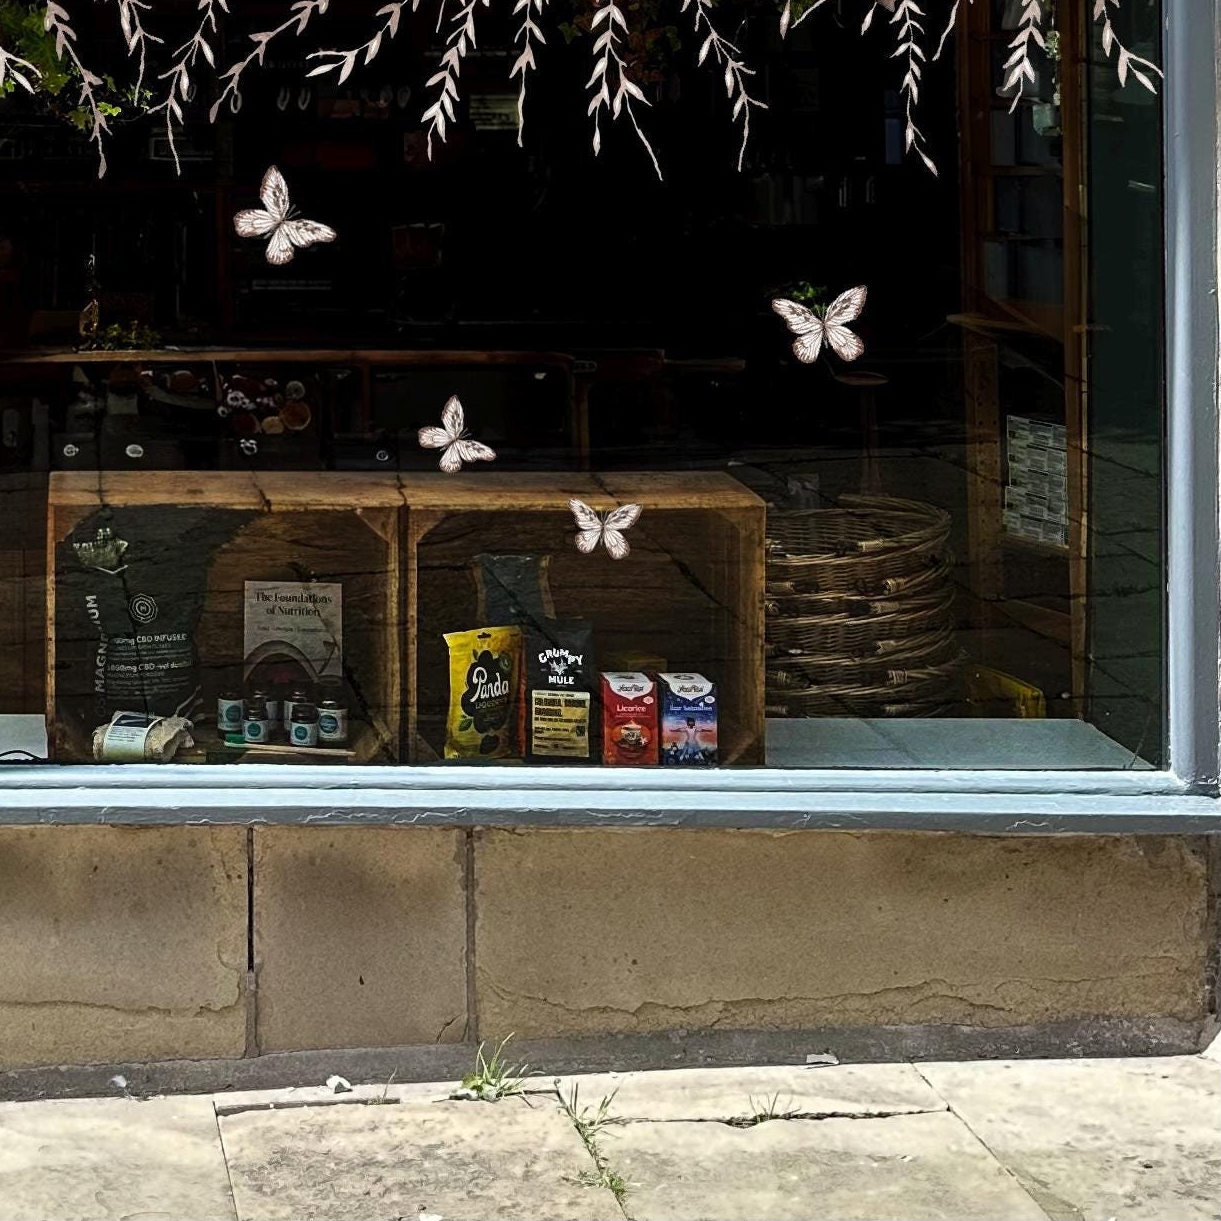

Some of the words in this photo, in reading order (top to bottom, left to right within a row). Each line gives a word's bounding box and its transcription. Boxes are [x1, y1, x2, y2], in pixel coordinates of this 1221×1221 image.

[256, 592, 272, 603] The
[274, 591, 333, 604] Foundations
[266, 605, 275, 615] of
[278, 605, 319, 616] Nutrition
[538, 648, 583, 666] GRUMPY
[470, 666, 510, 703] Panda
[548, 676, 575, 685] MULE
[616, 704, 647, 713] Licorice
